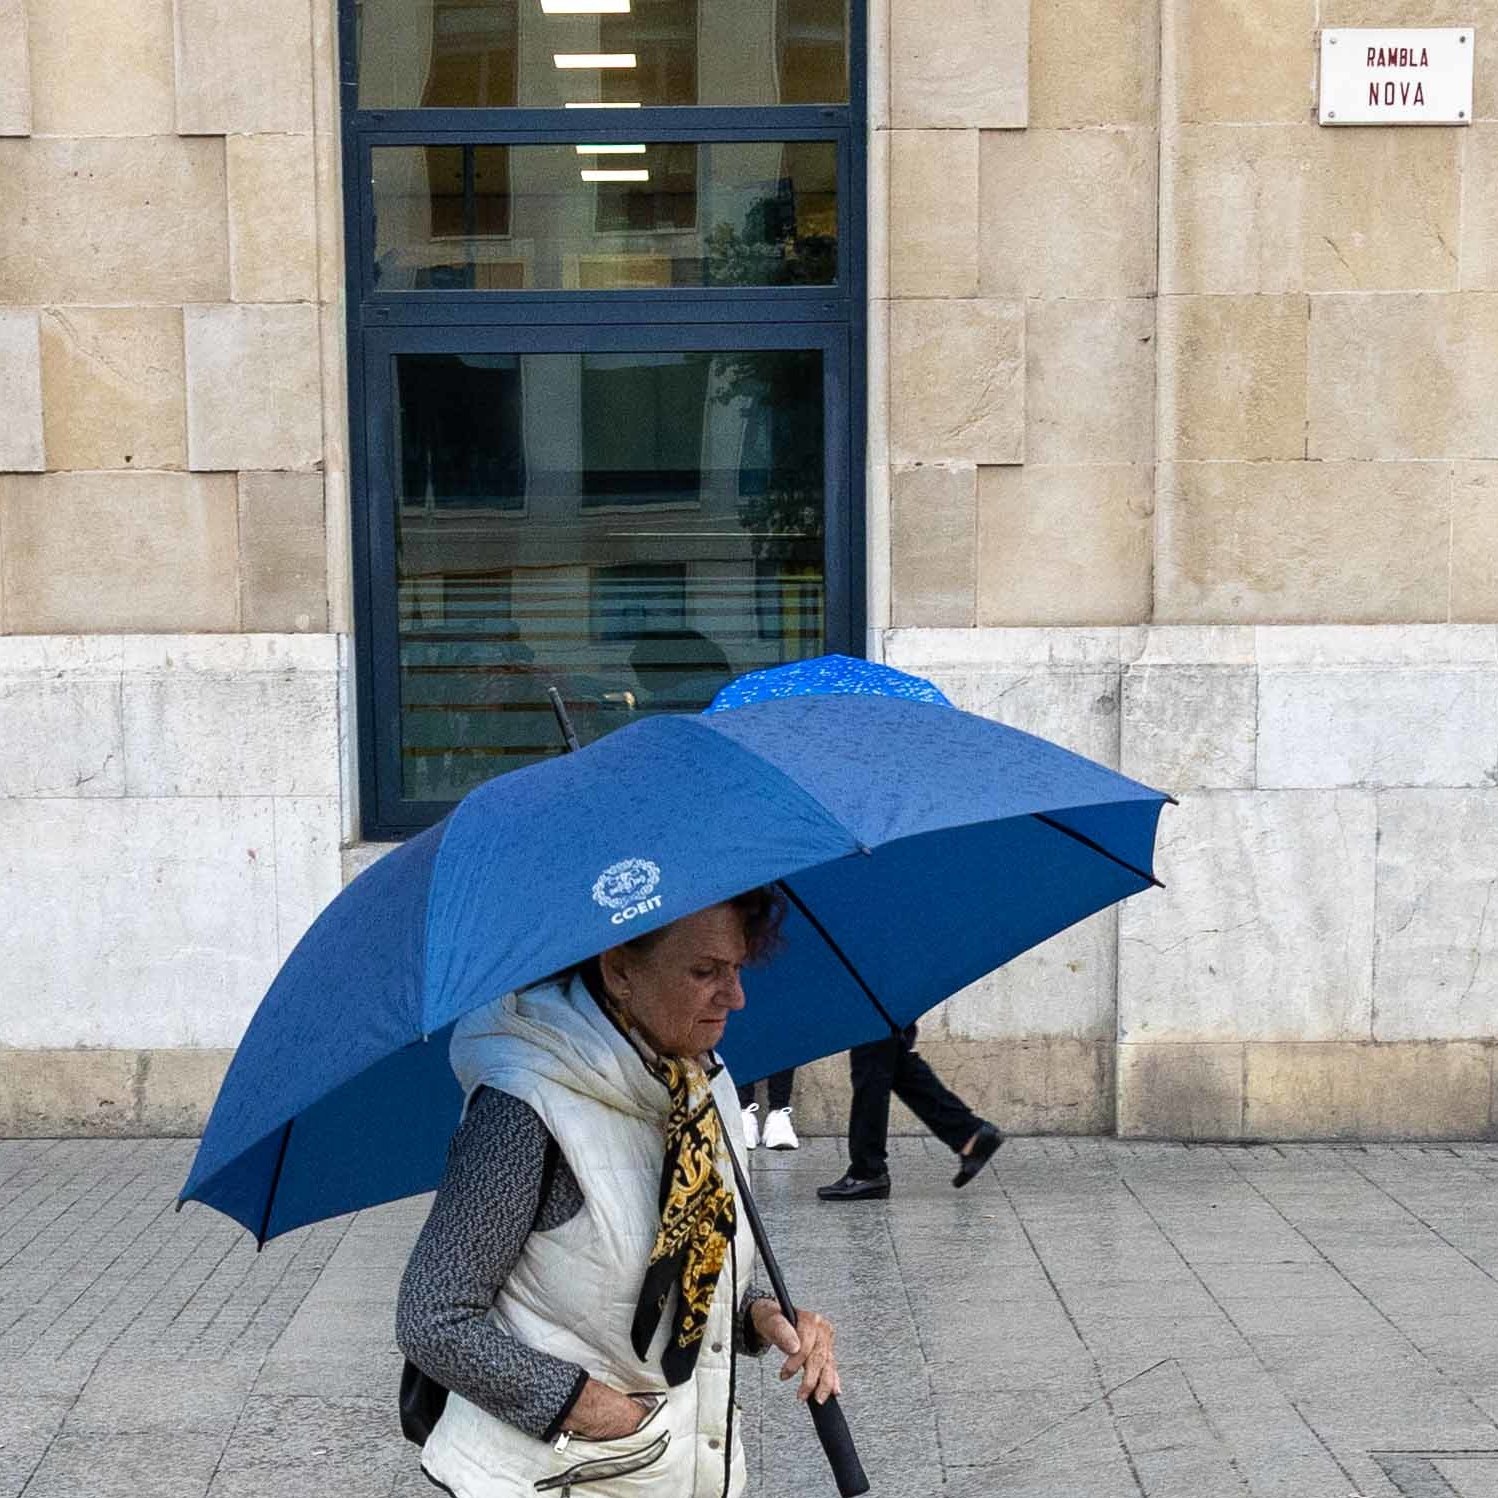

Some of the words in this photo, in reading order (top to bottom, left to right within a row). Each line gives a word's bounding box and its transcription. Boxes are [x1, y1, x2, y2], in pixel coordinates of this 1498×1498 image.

[1367, 47, 1428, 67] RAMBLA
[1369, 82, 1425, 106] NOVA
[611, 895, 662, 924] COEIT
